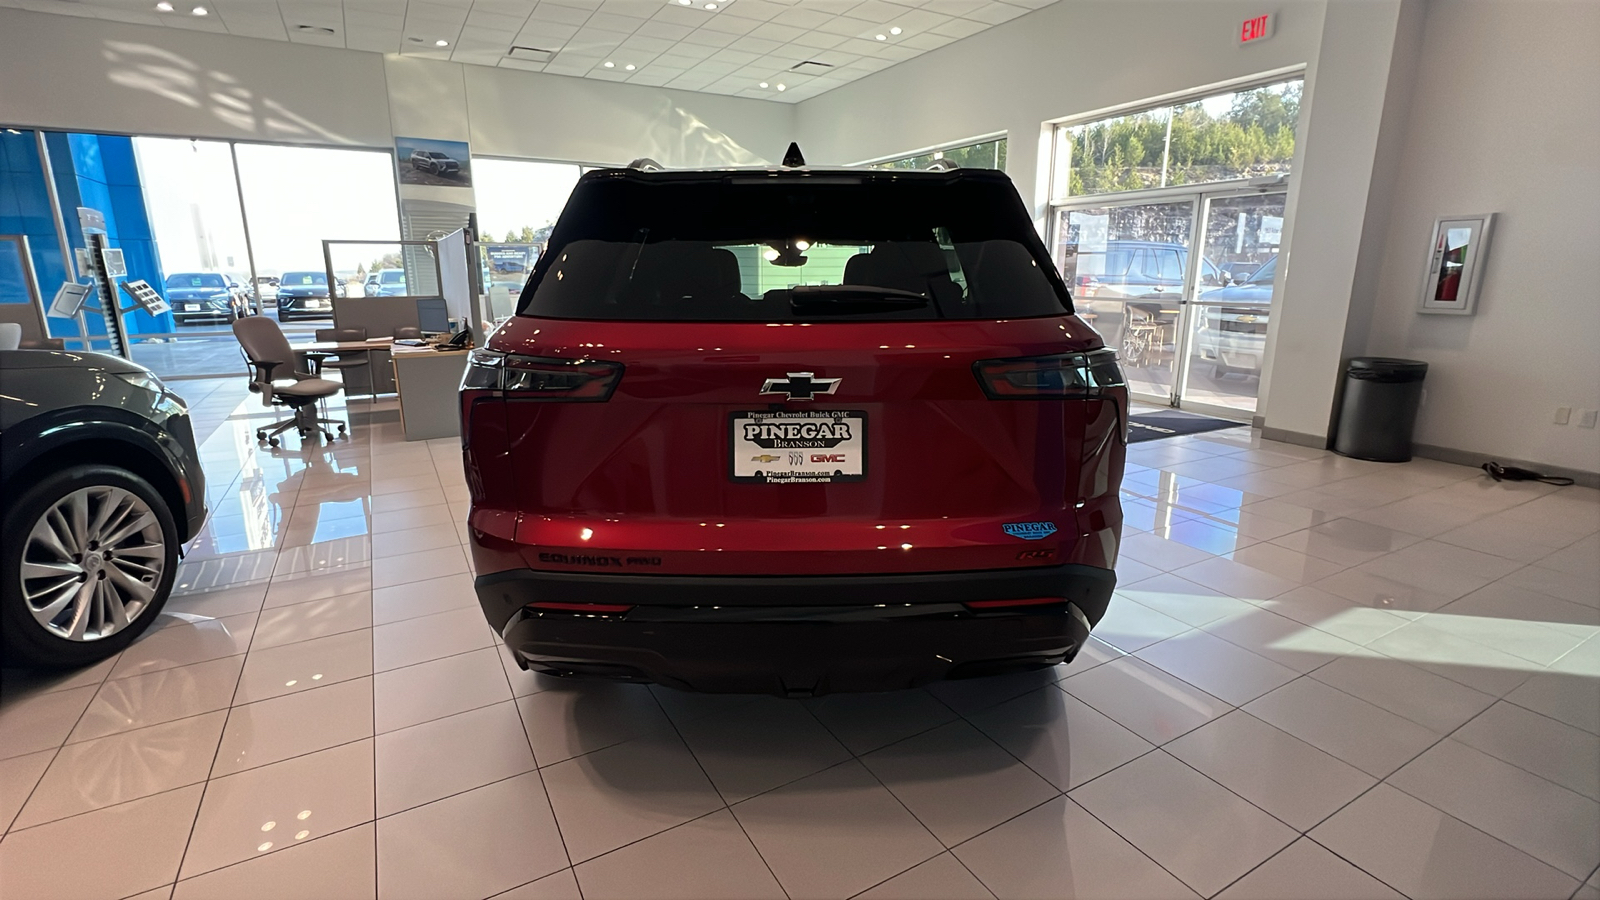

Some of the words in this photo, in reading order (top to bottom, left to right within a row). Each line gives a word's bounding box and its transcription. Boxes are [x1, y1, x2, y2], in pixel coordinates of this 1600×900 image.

[1241, 14, 1269, 42] EXIT
[745, 424, 850, 439] PINEGAR
[810, 454, 846, 463] GMC
[1004, 523, 1056, 532] PINEGAR
[538, 552, 622, 567] EQUINOX
